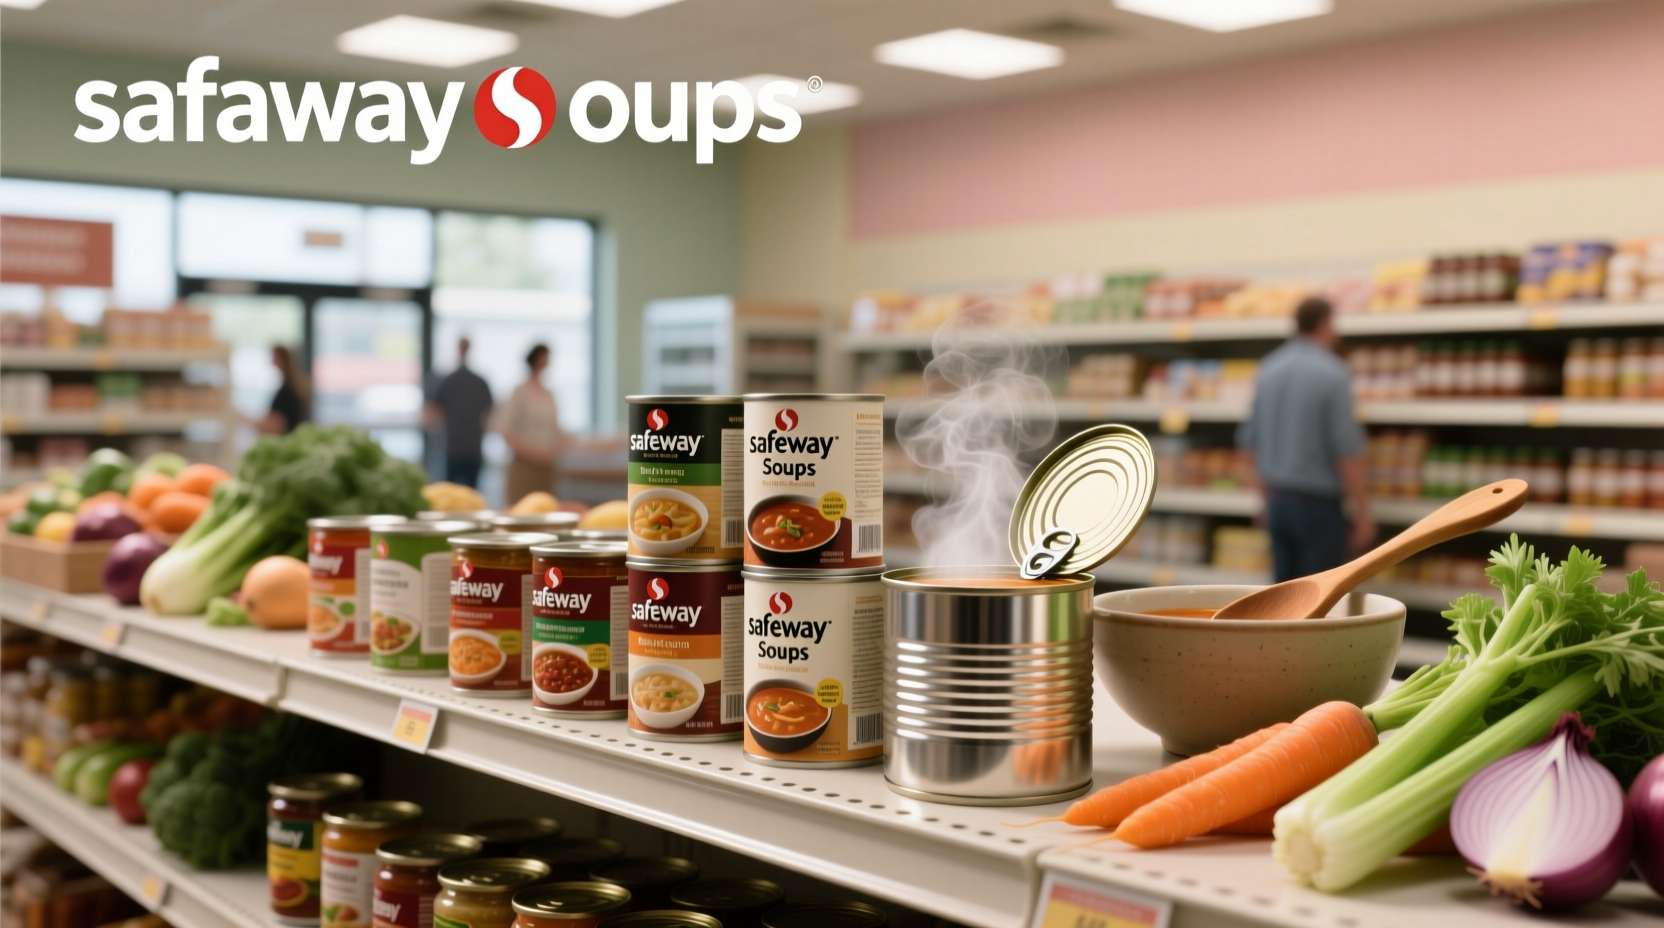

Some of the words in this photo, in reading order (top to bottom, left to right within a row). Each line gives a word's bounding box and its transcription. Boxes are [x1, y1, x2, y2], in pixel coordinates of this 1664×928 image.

[630, 429, 702, 457] safeway
[749, 430, 834, 460] safeway
[762, 458, 817, 481] Soups
[450, 577, 504, 603] afeway
[631, 599, 703, 628] safeway
[748, 613, 828, 645] safeway
[758, 641, 810, 665] Soups
